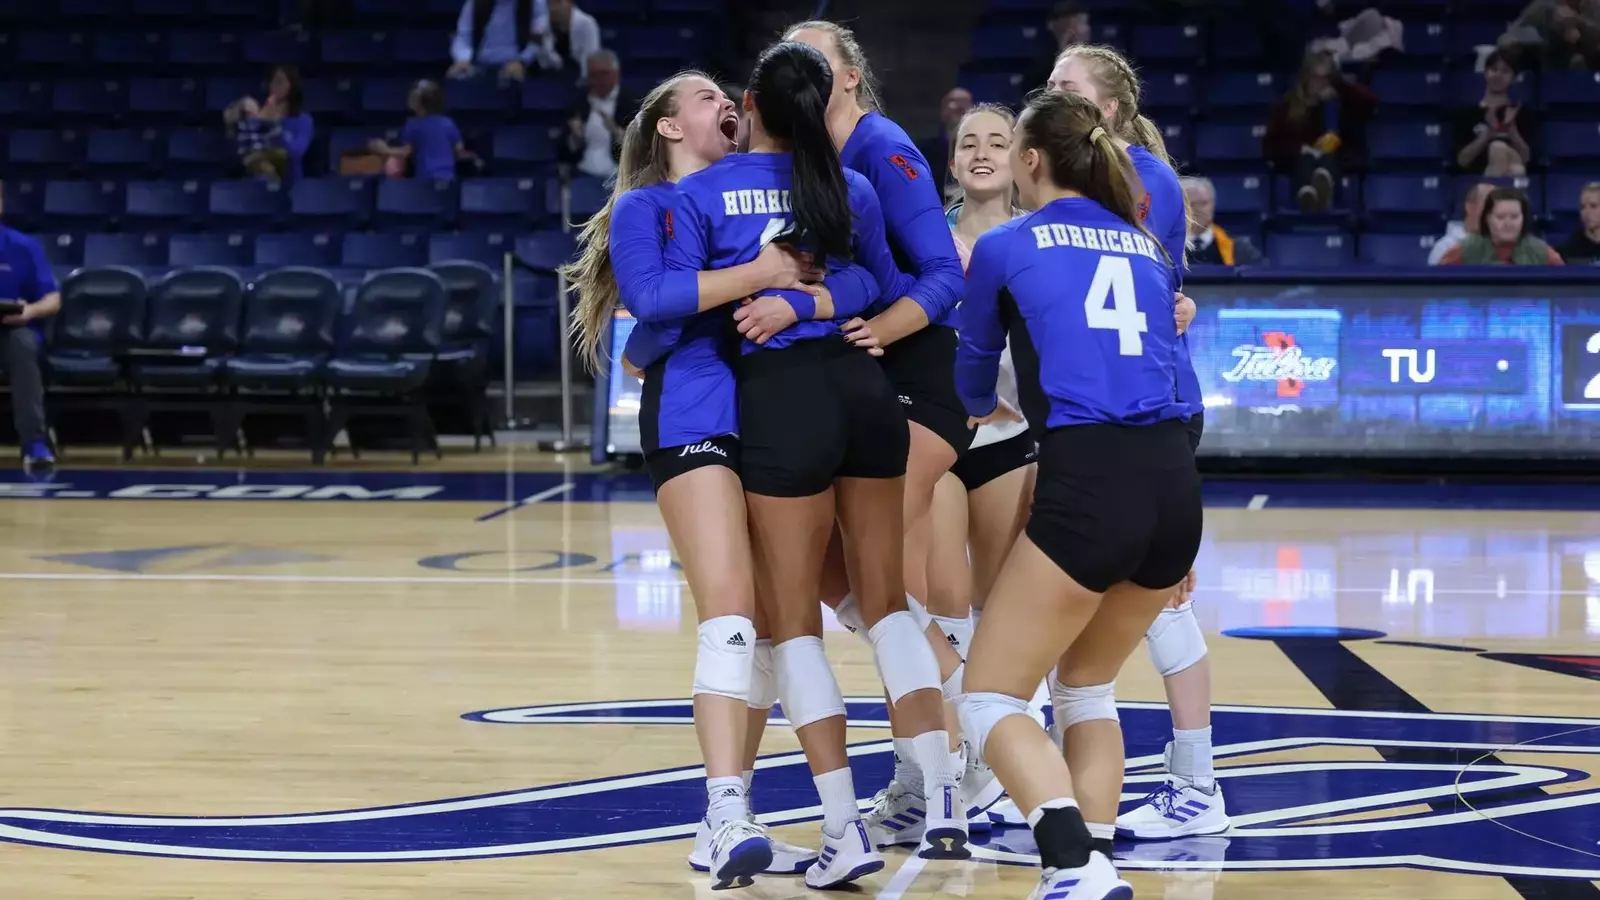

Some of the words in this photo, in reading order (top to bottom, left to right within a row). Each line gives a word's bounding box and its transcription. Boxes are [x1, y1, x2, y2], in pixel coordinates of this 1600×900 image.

[722, 189, 793, 216] HURRI
[1084, 254, 1148, 356] 4
[1382, 349, 1435, 383] TU
